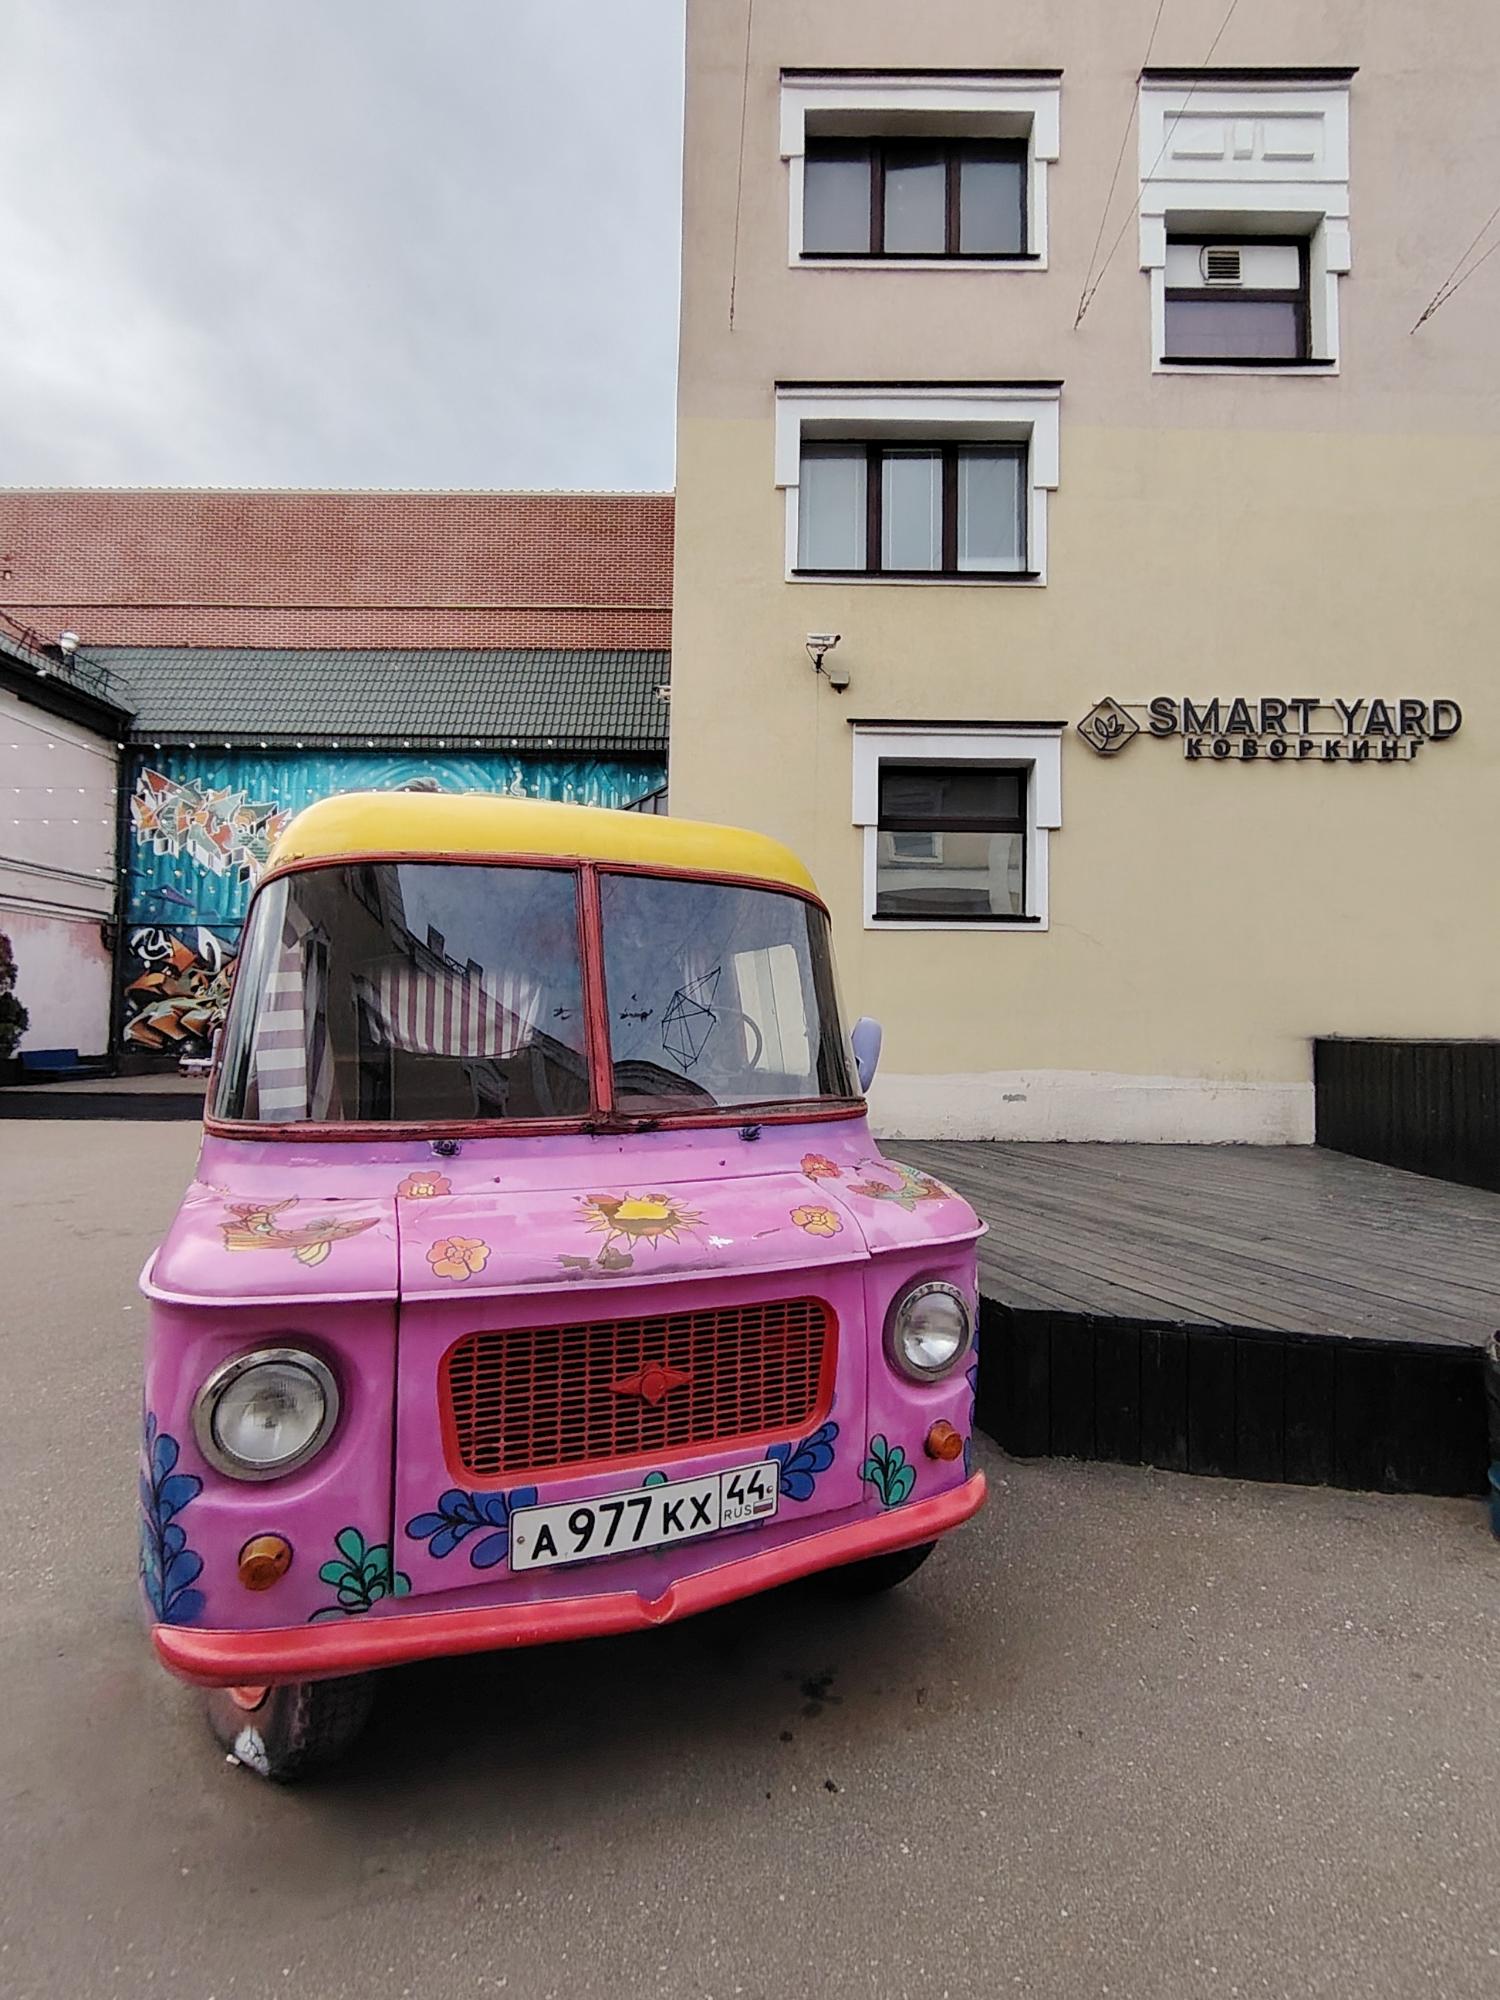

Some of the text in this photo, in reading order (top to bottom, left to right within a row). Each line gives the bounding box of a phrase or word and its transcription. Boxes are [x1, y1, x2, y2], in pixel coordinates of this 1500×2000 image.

[1148, 696, 1463, 741] SMART YARD
[1185, 738, 1424, 761] КОВОРКИНГ
[726, 1470, 764, 1505] 44
[724, 1505, 752, 1521] RUS
